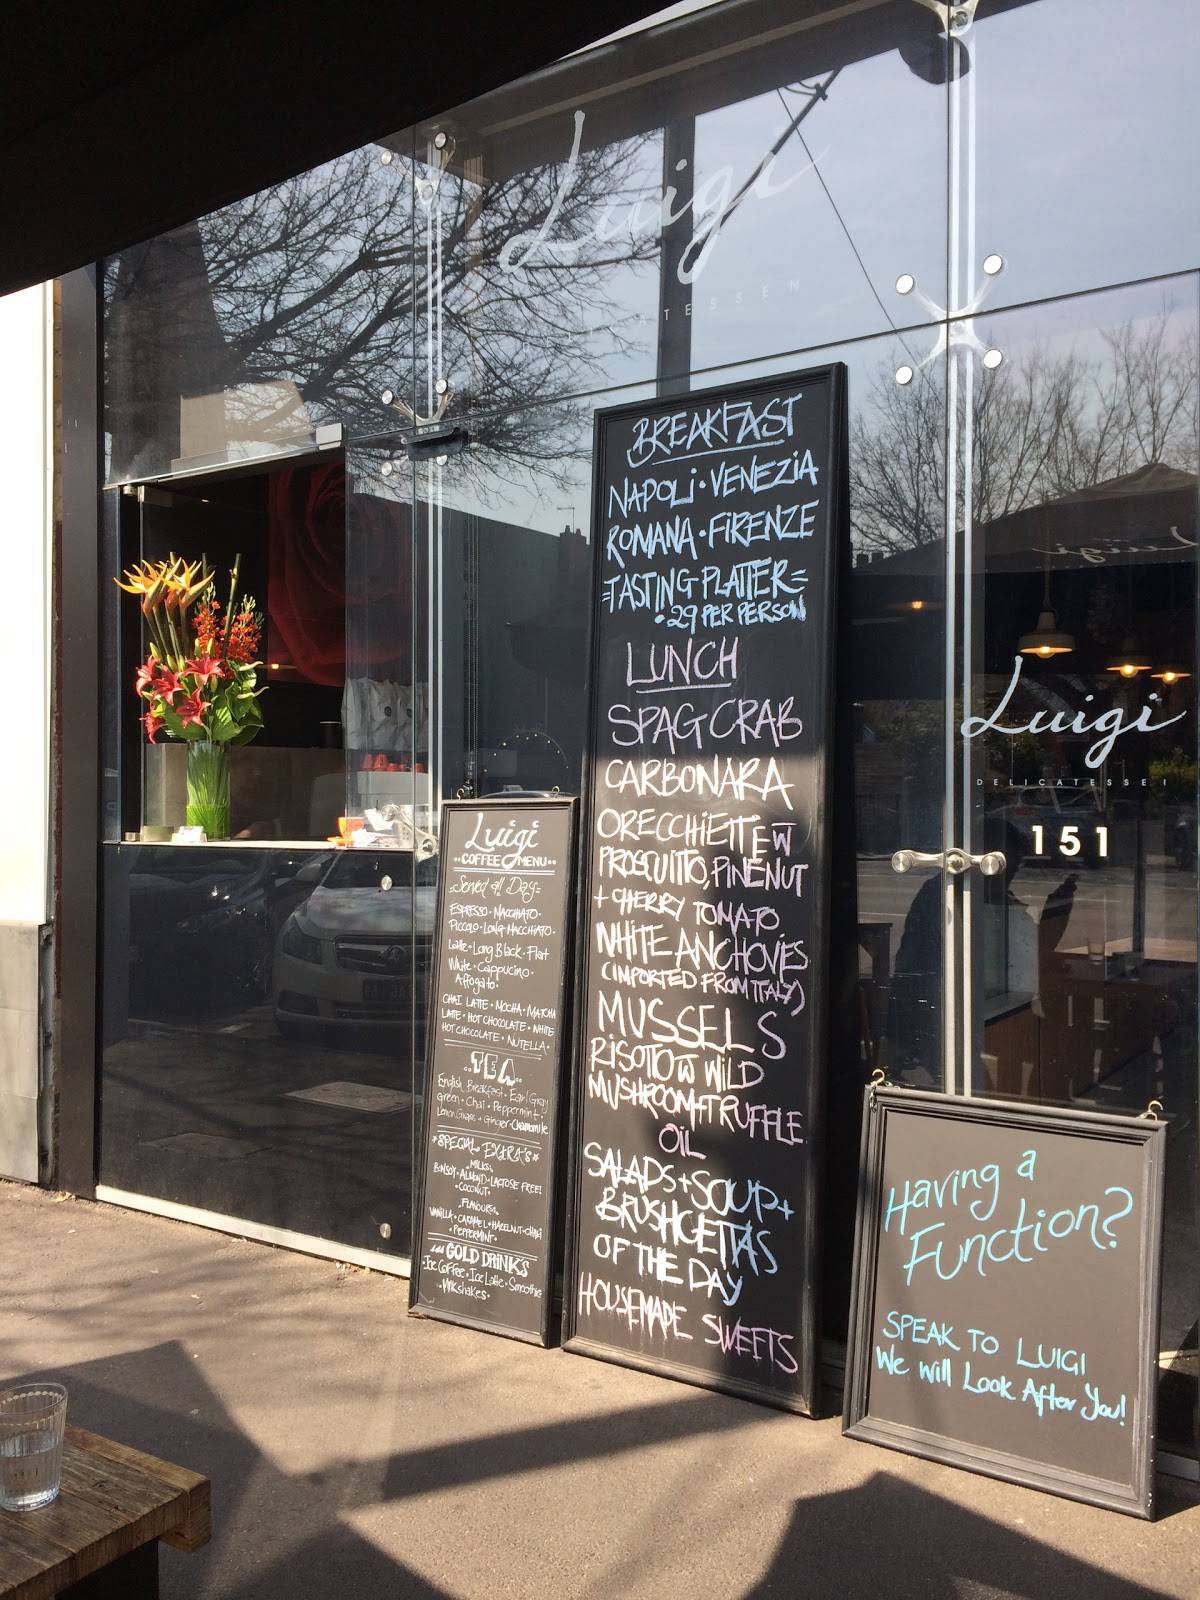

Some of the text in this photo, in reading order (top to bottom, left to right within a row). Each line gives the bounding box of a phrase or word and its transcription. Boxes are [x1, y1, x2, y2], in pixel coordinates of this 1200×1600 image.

[499, 110, 831, 285] Luigi
[627, 393, 802, 467] BREAKFAST
[606, 515, 698, 568] ROMANA
[701, 603, 733, 628] PER
[738, 594, 806, 625] PERSON
[626, 636, 739, 687] LUNCH
[608, 696, 803, 754] SPAG CRAB
[960, 655, 1188, 769] Luigi
[604, 754, 795, 811] CARBONARA
[461, 853, 502, 867] COFFEE
[465, 812, 540, 869] Luigi
[1032, 825, 1109, 858] 151
[612, 888, 685, 921] CHERRY
[693, 900, 780, 936] TOMATO
[473, 941, 493, 962] Long
[494, 942, 522, 959] Black
[527, 945, 550, 960] Flat
[466, 997, 489, 1010] LATTE
[700, 972, 749, 1000] FROM
[455, 1026, 500, 1042] CHOCOLATE
[507, 1035, 548, 1056] NUTELLA
[467, 1012, 483, 1023] HOT
[483, 1015, 527, 1032] CHOCOLATE
[598, 990, 787, 1059] MUSSELS
[470, 1050, 516, 1087] TEA
[884, 1150, 1036, 1235] Having a
[593, 1234, 631, 1265] OF
[631, 1242, 684, 1285] THE
[903, 1187, 1133, 1286] Function?
[578, 1272, 798, 1374] HOUSEMADE SWEETS
[882, 1311, 1087, 1376] SPEAK TO LUIGI
[876, 1344, 910, 1375] We
[962, 1361, 1016, 1400] Look
[1022, 1377, 1076, 1416] After
[1080, 1383, 1127, 1426] You!
